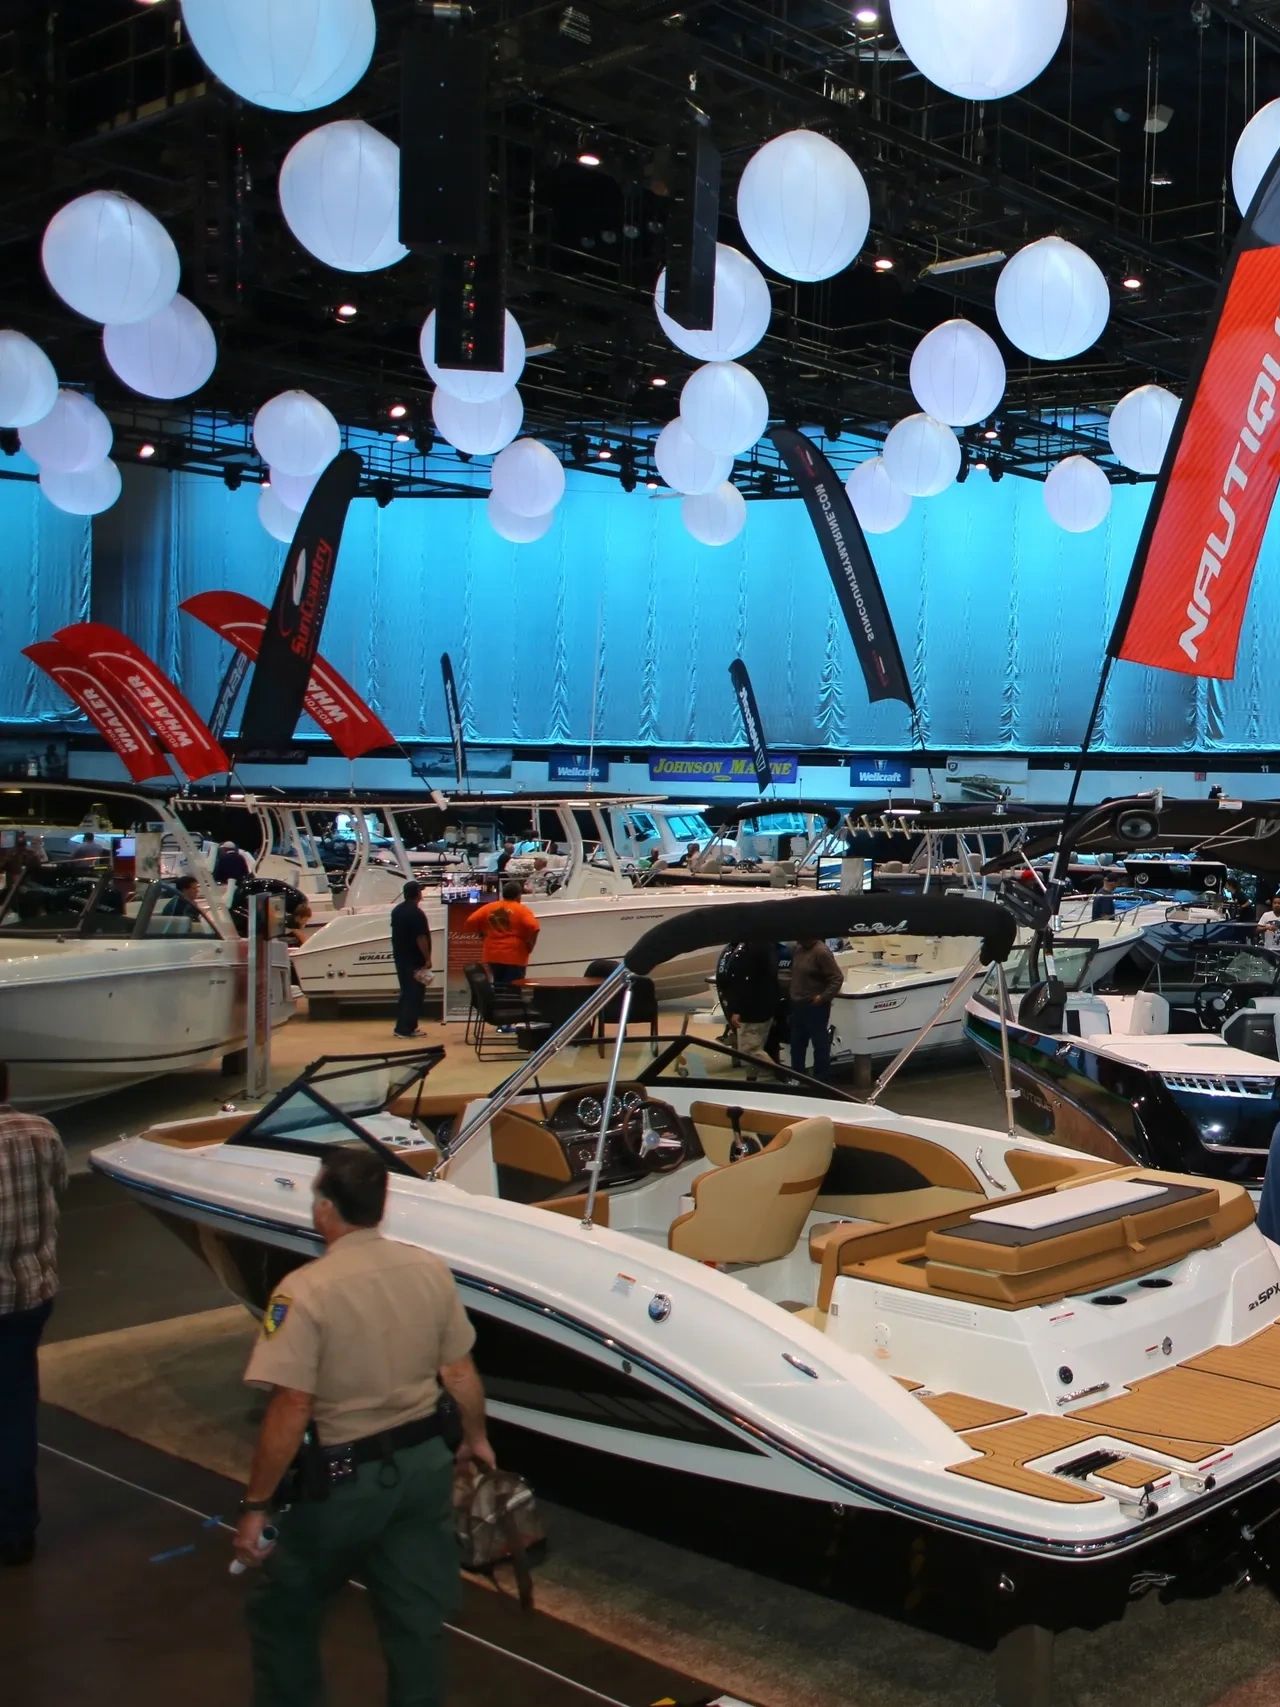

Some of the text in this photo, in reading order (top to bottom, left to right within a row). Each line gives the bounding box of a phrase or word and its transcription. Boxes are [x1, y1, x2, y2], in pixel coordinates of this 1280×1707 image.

[127, 674, 194, 748] WHALER
[307, 677, 348, 723] WHA
[82, 687, 140, 753] WHALER
[557, 766, 600, 777] Wellcraft
[653, 758, 723, 774] JOHNSON
[859, 771, 902, 782] Wellcraft
[1258, 1282, 1280, 1305] SPX
